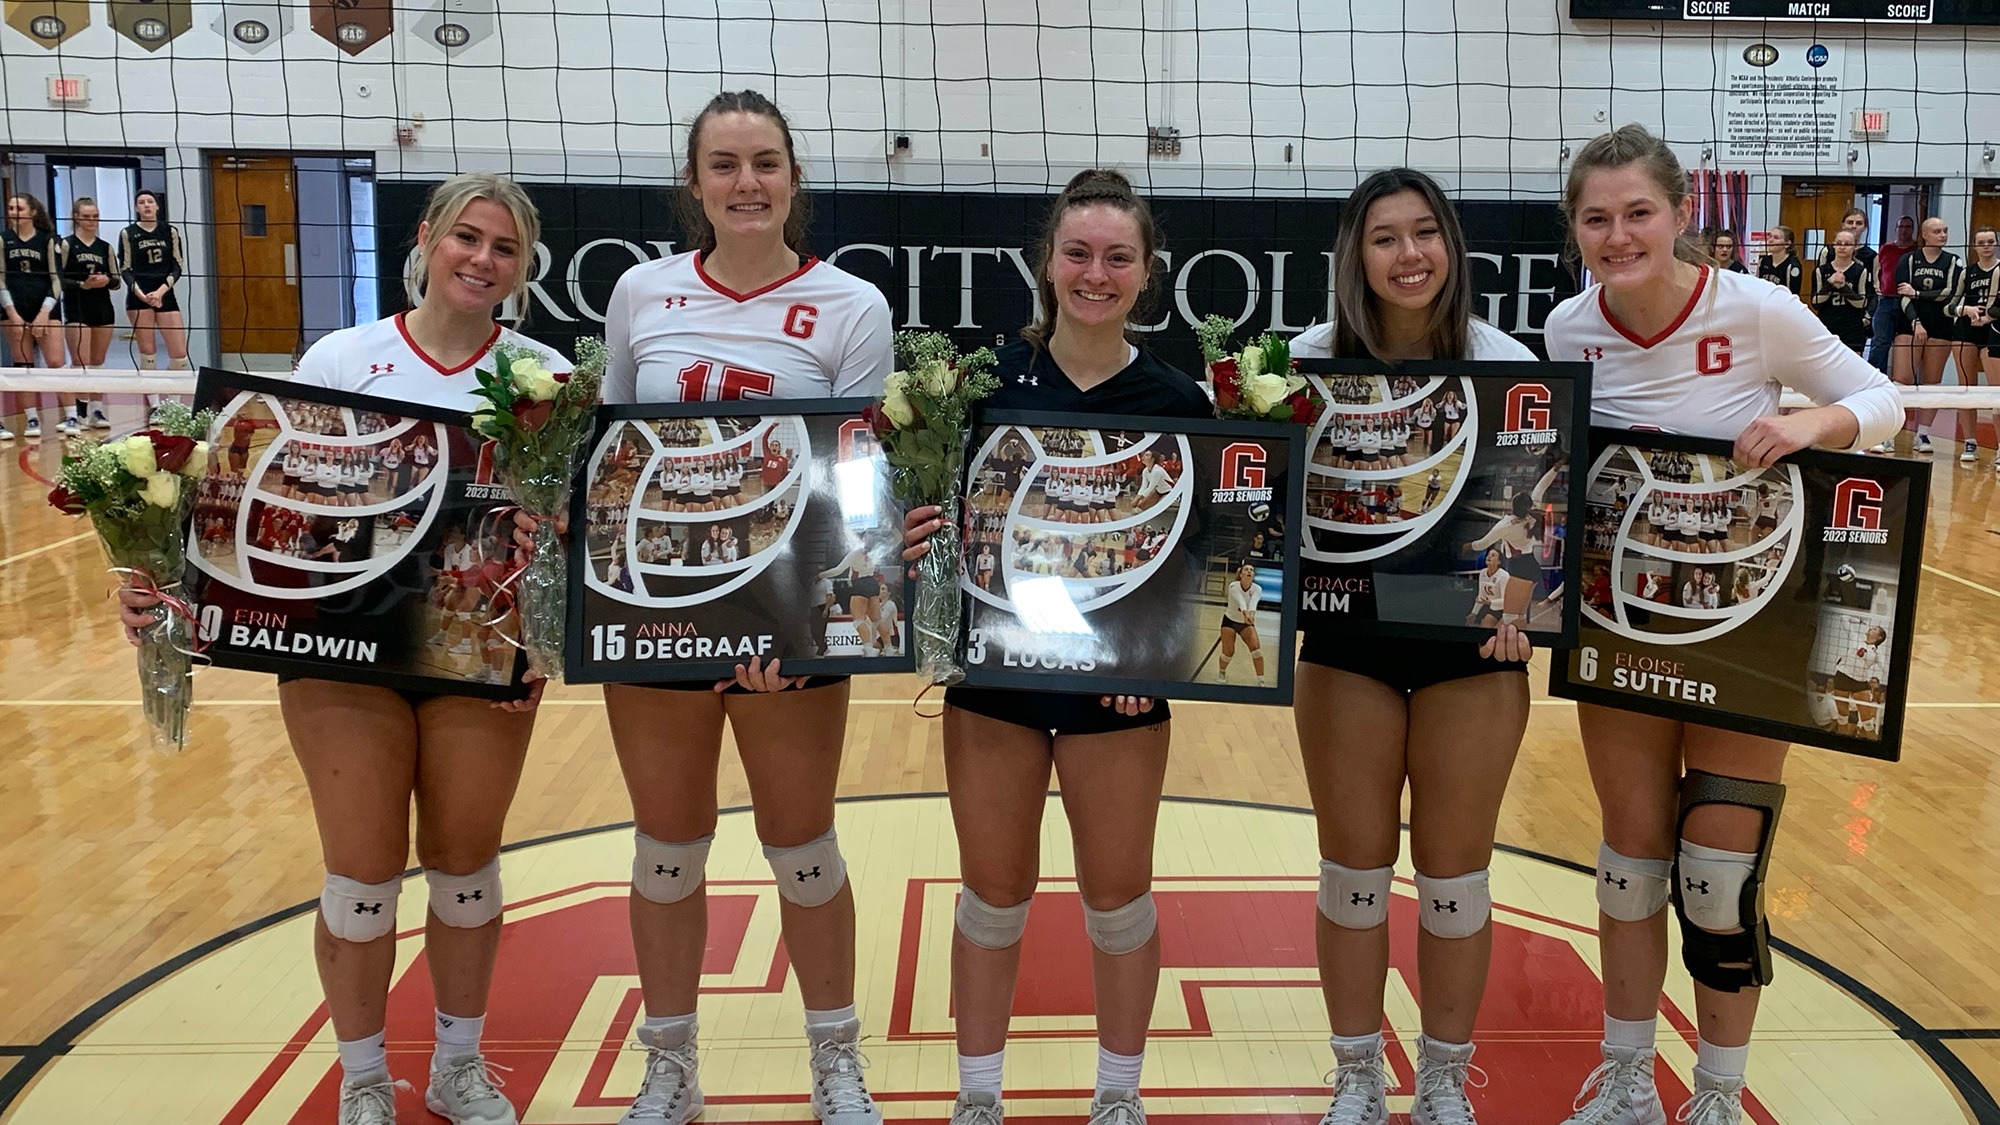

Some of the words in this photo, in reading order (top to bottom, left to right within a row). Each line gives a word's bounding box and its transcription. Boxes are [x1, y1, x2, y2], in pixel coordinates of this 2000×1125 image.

[1690, 1, 1730, 14] SCORE
[1788, 3, 1831, 16] MATCH
[1887, 4, 1927, 17] SCORE
[36, 22, 59, 33] PAC
[139, 25, 161, 35] PAC
[240, 27, 261, 37] PAC
[342, 29, 363, 40] PAC
[1750, 50, 1771, 61] PAC
[55, 79, 79, 97] EXIT
[1862, 113, 1882, 130] EXIT
[9, 249, 41, 260] GENEVA
[146, 249, 163, 264] 12
[1914, 268, 1944, 279] GENEVA
[1143, 248, 1559, 335] OLGE
[1923, 278, 1934, 290] 9
[1971, 278, 1990, 290] GENE
[781, 302, 820, 340] G
[1696, 334, 1732, 375] G
[1505, 383, 1551, 433] G
[1496, 434, 1519, 446] 2023
[1520, 432, 1557, 445] SENIORS
[1220, 443, 1267, 490] G
[464, 486, 489, 499] 2023
[1211, 491, 1235, 503] 2023
[1236, 490, 1273, 502] SENIORS
[1832, 477, 1884, 531] G
[1822, 530, 1847, 542] 2023
[1848, 531, 1888, 544] SENIORS
[1304, 575, 1371, 594] GRACE
[1302, 591, 1350, 613] KIM
[234, 609, 288, 629] ERIN
[229, 625, 377, 663] BALDWIN
[591, 624, 626, 661] 15
[636, 622, 698, 638] ANNA
[635, 635, 773, 660] DEGRAAF
[1580, 647, 1599, 682] 6
[1615, 652, 1685, 678] ELOISE
[1613, 667, 1718, 705] SUTTER
